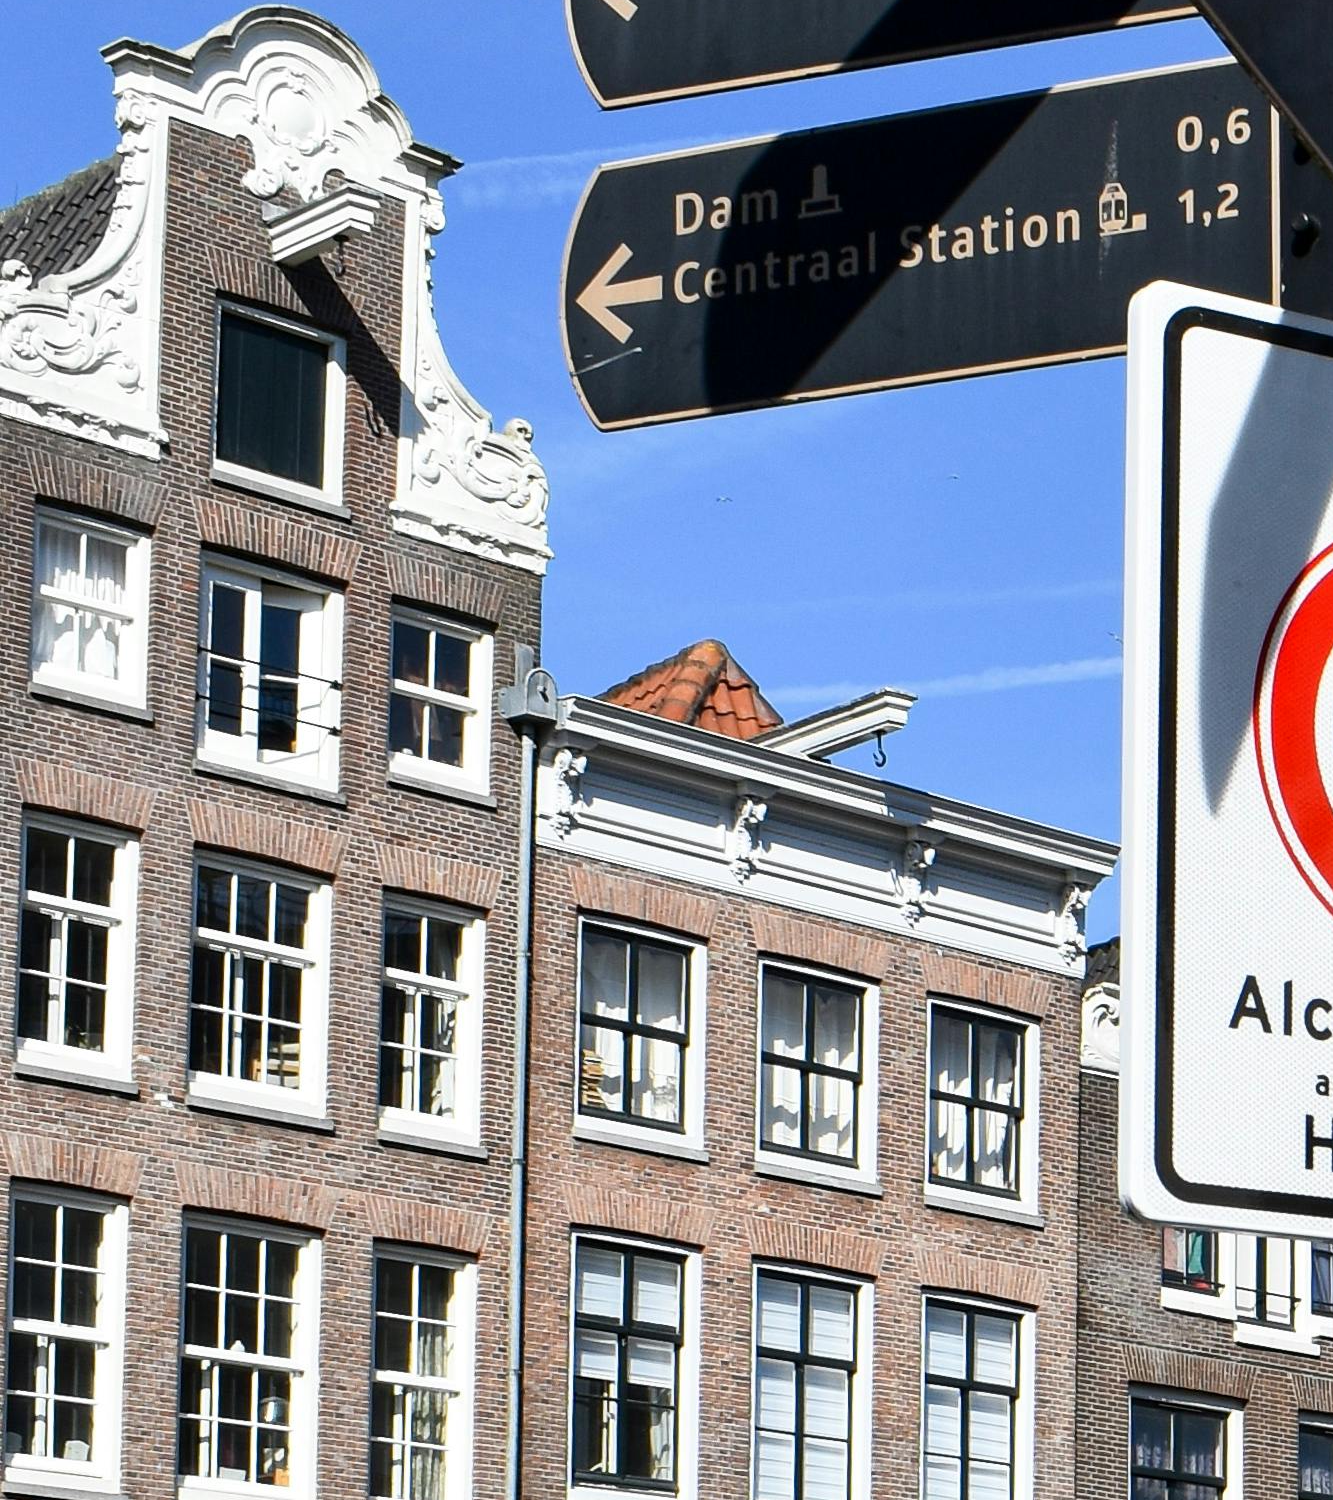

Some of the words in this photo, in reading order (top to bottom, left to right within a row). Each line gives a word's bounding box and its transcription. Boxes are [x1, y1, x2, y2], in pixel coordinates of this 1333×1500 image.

[675, 185, 779, 237] Dam
[1176, 107, 1251, 158] 0,6
[672, 231, 876, 306] Centraal
[899, 203, 1082, 269] Station
[1176, 183, 1241, 228] 1,2
